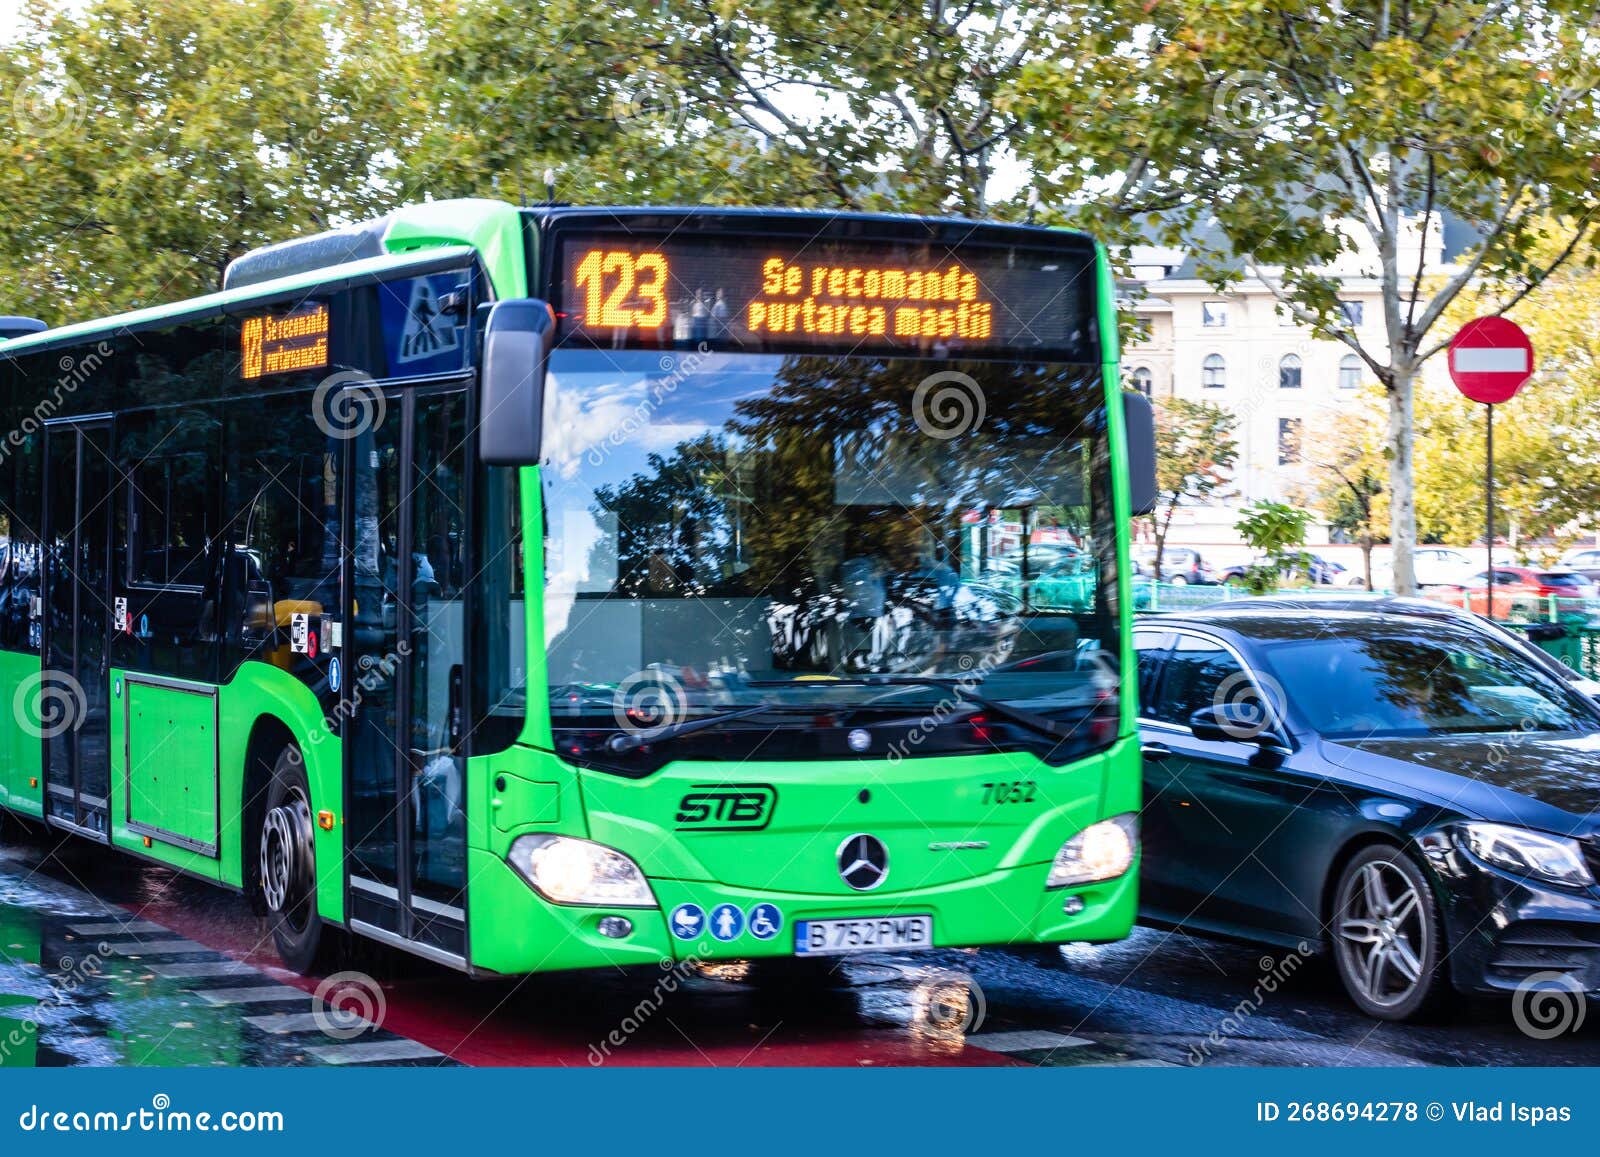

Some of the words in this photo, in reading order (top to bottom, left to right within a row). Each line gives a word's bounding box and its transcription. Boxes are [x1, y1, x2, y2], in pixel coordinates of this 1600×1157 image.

[575, 250, 669, 328] 123
[763, 257, 802, 295] Se
[811, 265, 977, 301] recomanda
[748, 296, 886, 335] purtarea
[675, 793, 767, 822] STB
[981, 781, 1036, 804] 7052
[809, 924, 827, 948] B
